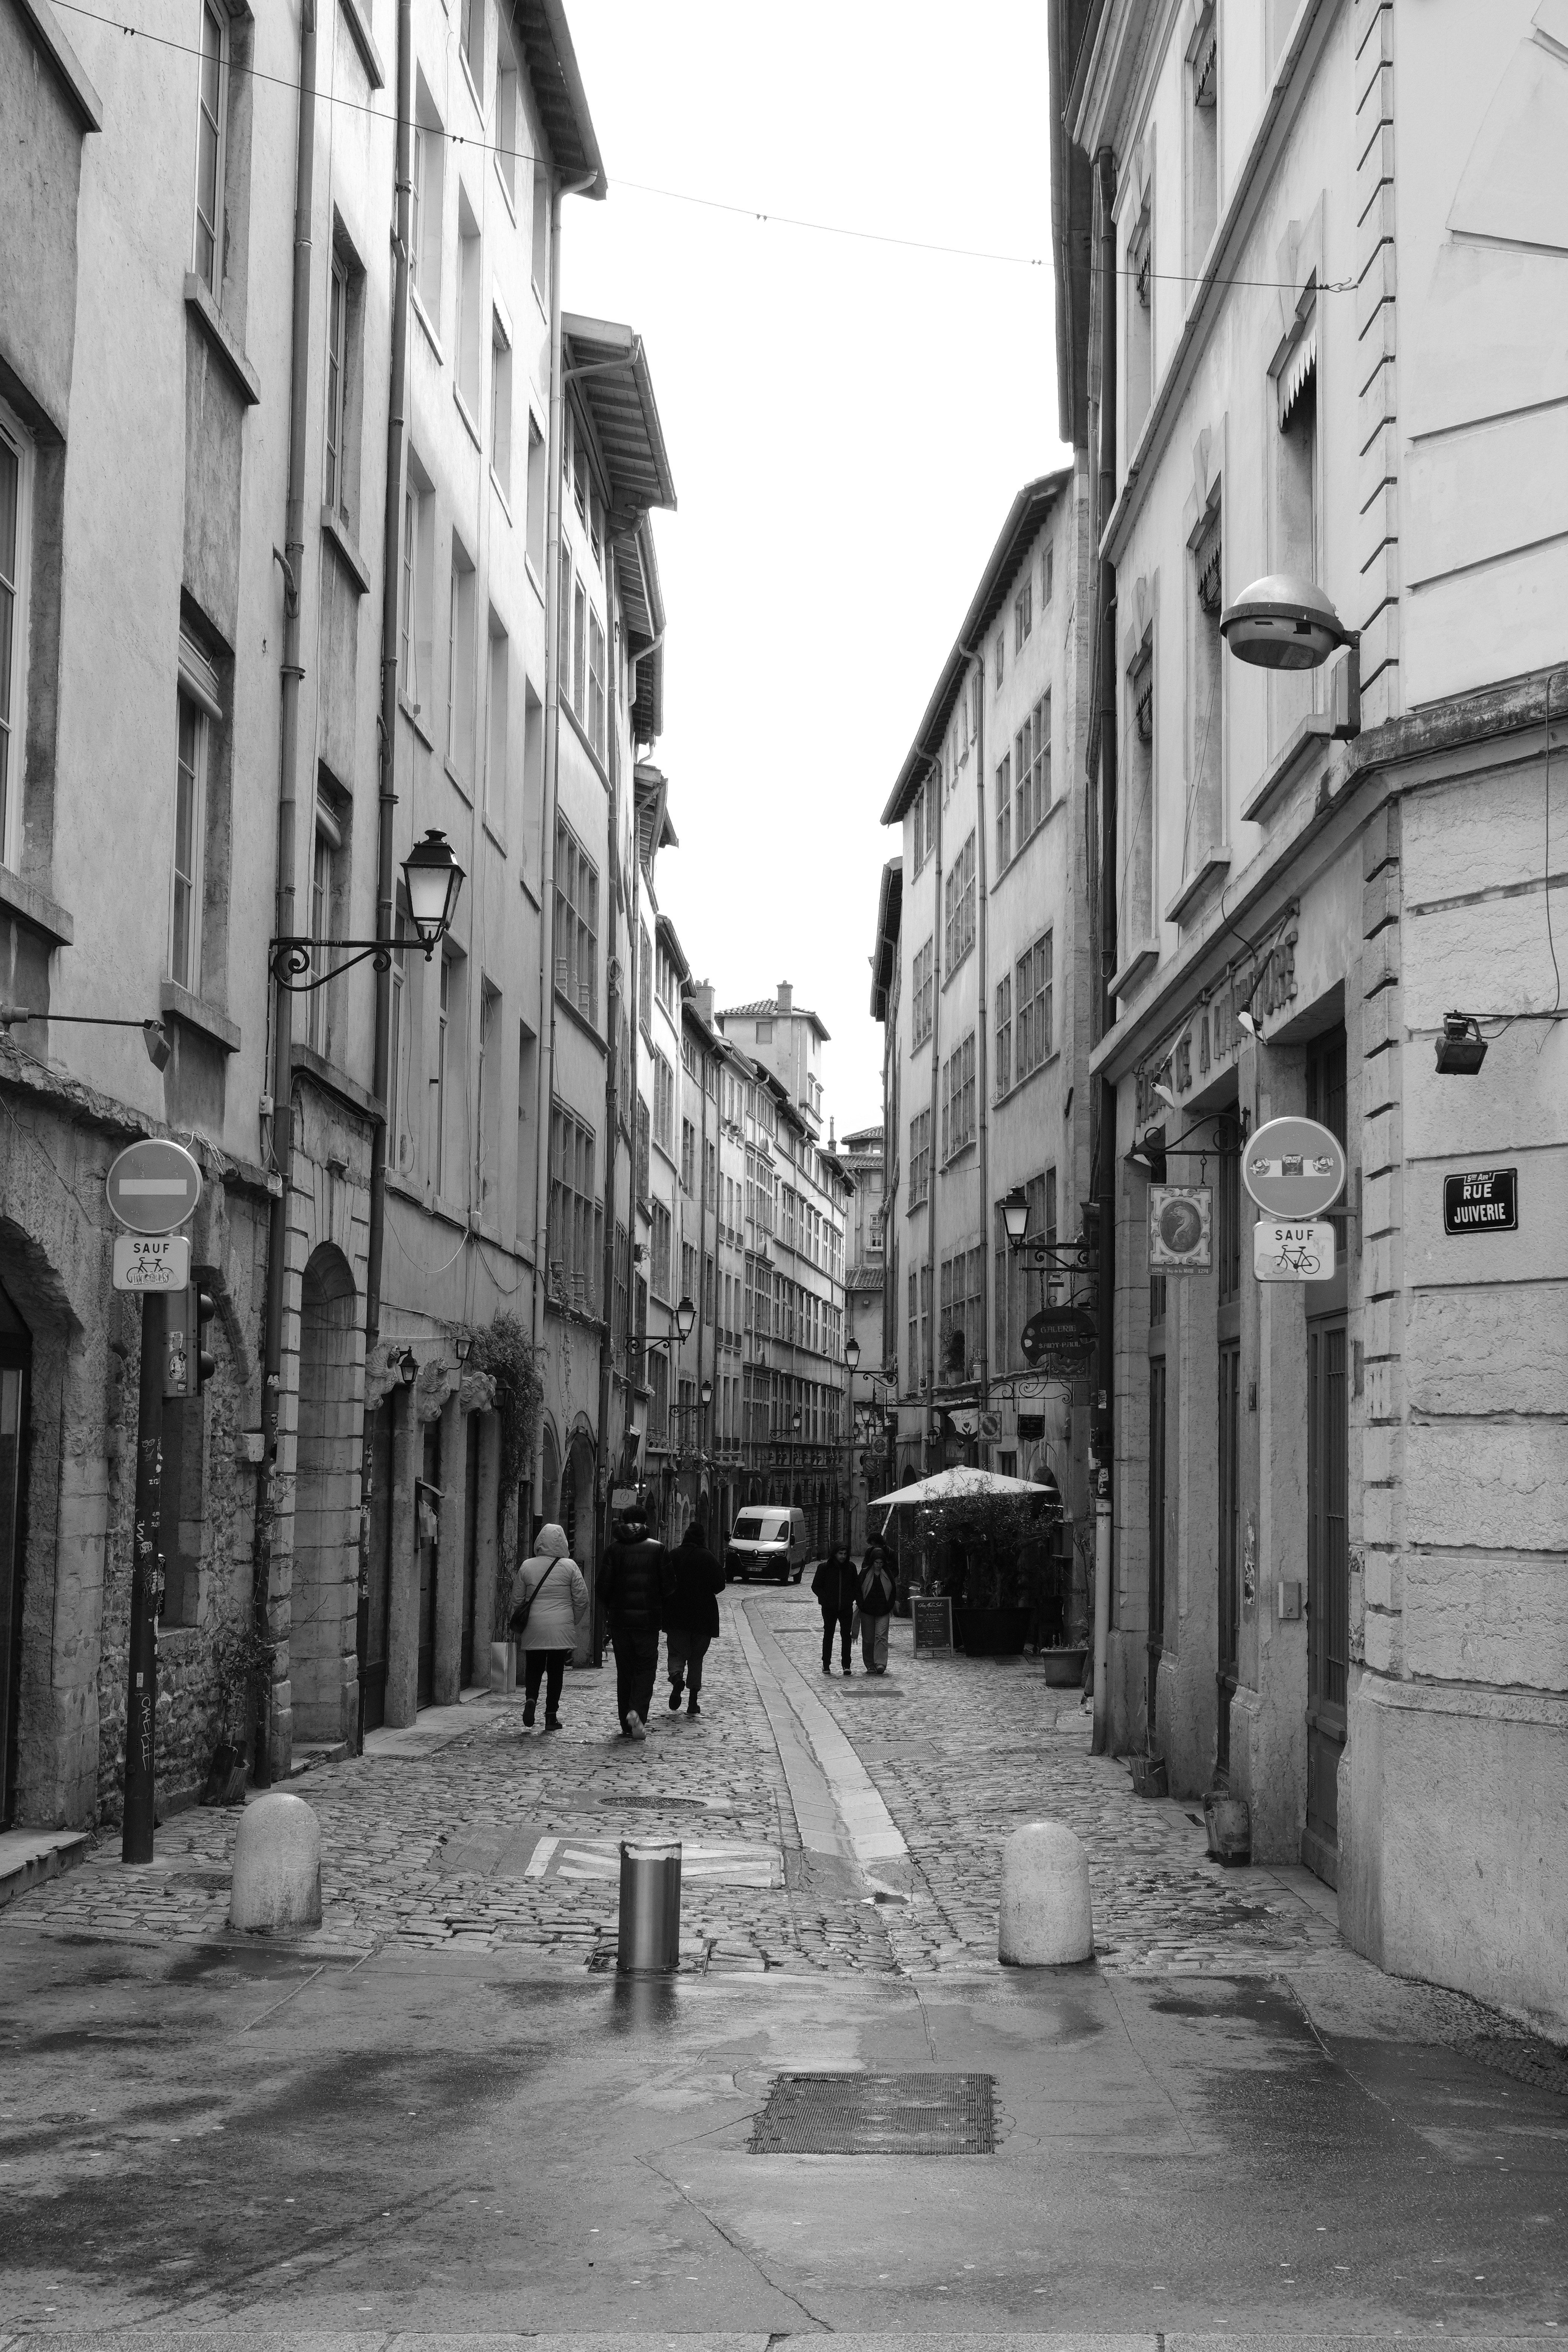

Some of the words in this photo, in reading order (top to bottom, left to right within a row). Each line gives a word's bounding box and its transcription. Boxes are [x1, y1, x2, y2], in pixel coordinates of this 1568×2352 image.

[1463, 1184, 1492, 1200] RUE
[1454, 1203, 1506, 1223] JUIVERIE
[1275, 1230, 1314, 1241] SAUF
[133, 1243, 170, 1254] SAUF
[1040, 1325, 1076, 1333] GALERIE
